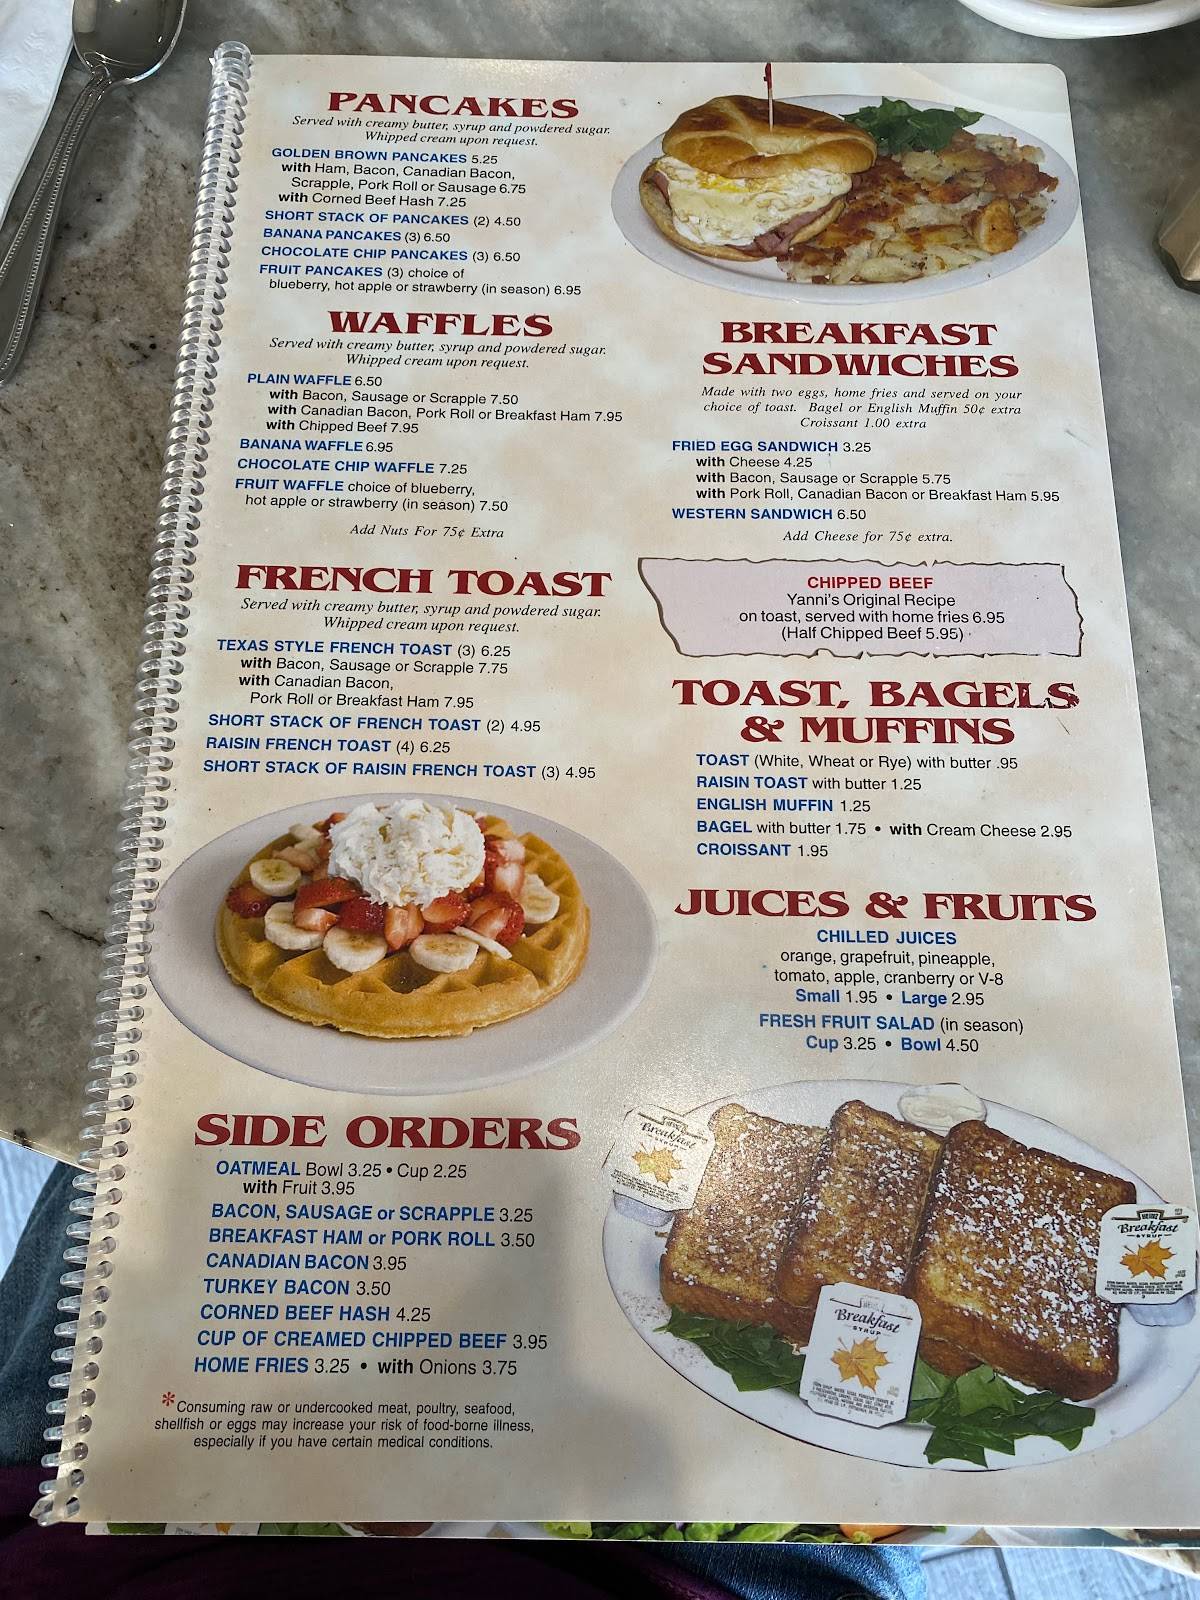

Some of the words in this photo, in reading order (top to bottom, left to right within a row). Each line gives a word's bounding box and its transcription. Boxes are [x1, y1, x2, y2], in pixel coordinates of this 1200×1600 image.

[328, 92, 578, 118] PANCAKES
[292, 115, 334, 126] Served
[337, 117, 362, 127] with
[365, 120, 409, 131] creamy
[412, 119, 449, 131] butter,
[452, 123, 486, 134] syrup
[489, 122, 513, 133] and
[514, 124, 573, 135] powdered
[576, 127, 611, 137] sugar.
[272, 147, 330, 159] GOLDEN
[335, 150, 387, 161] BROWN
[392, 152, 467, 163] PANCAKES
[471, 154, 498, 165] 5.25
[291, 176, 353, 190] Scrapple,
[358, 179, 389, 191] Pork
[393, 180, 418, 191] Roll
[421, 183, 434, 192] or
[438, 182, 496, 195] Sausage
[499, 183, 526, 194] 6.75
[261, 246, 348, 258] CHOCOLATE
[353, 248, 387, 259] CHIP
[391, 249, 468, 261] PANCAKES
[472, 251, 489, 263] (3)
[493, 252, 520, 262] 6.50
[269, 278, 330, 292] blueberry,
[334, 280, 355, 291] hot
[358, 281, 392, 294] apple
[396, 283, 409, 292] or
[412, 283, 478, 295] strawberry
[481, 284, 497, 296] (in
[500, 284, 550, 297] season)
[554, 286, 581, 296] 6.95
[328, 311, 553, 337] WAFFLES
[720, 322, 997, 345] BREAKFAST
[346, 353, 402, 368] Whipped
[405, 357, 443, 367] cream
[446, 358, 477, 369] upon
[481, 359, 529, 371] request.
[703, 353, 1019, 378] SANDWICHES
[247, 373, 290, 385] PLAIN
[294, 374, 351, 386] WAFFLE
[354, 376, 382, 387] 6.50
[266, 419, 295, 431] with
[299, 420, 353, 434] Chipped
[357, 422, 387, 433] Beef
[390, 423, 419, 433] 7.95
[800, 417, 858, 428] Croissant
[864, 417, 891, 428] 1.00
[895, 418, 927, 429] extra
[672, 440, 715, 452] FRIED
[720, 440, 752, 452] EGG
[757, 441, 838, 452] SANDWICH
[843, 442, 871, 453] 3.25
[237, 458, 330, 471] CHOCOLATE
[335, 460, 370, 472] CHIP
[374, 462, 434, 474] WAFFLE
[439, 464, 467, 475] 7.25
[696, 456, 725, 467] with
[729, 456, 780, 467] Cheese
[783, 457, 813, 467] 4.25
[696, 471, 725, 483] with
[730, 471, 775, 485] Bacon,
[780, 472, 838, 486] Sausage
[842, 474, 856, 485] or
[860, 472, 918, 486] Scrapple
[922, 473, 951, 485] 5.75
[672, 507, 746, 519] WESTERN
[750, 508, 832, 520] SANDWICH
[837, 509, 866, 520] 6.50
[349, 523, 376, 535] Add
[381, 524, 409, 536] Nuts
[414, 525, 438, 537] For
[471, 527, 504, 539] Extra
[235, 565, 434, 593] FRENCH
[448, 570, 612, 597] TOAST
[807, 576, 881, 589] CHIPPED
[889, 577, 933, 589] BEEF
[787, 593, 839, 606] Yanni's
[843, 593, 900, 608] Original
[904, 594, 956, 609] Recipe
[781, 627, 816, 642] (Half
[820, 627, 883, 642] Chipped
[887, 627, 922, 640] Beef
[926, 628, 964, 643] 5.95)
[217, 639, 269, 652] TEXAS
[274, 640, 324, 653] STYLE
[330, 642, 394, 654] FRENCH
[399, 644, 452, 656] TOAST
[457, 644, 476, 658] (3)
[481, 646, 511, 657] 6.25
[672, 680, 850, 708] TOAST,
[869, 682, 1079, 709] BAGELS
[740, 716, 784, 742] &
[800, 717, 1015, 745] MUFFINS
[206, 736, 260, 750] RAISIN
[266, 738, 331, 751] FRENCH
[337, 739, 391, 752] TOAST
[396, 740, 415, 755] (4)
[420, 742, 450, 754] 6.25
[696, 776, 749, 788] RAISIN
[754, 777, 808, 789] TOAST
[812, 777, 840, 790] with
[845, 778, 887, 790] butter
[891, 778, 922, 791] 1.25
[696, 798, 767, 811] ENGLISH
[773, 799, 833, 812] MUFFIN
[840, 800, 871, 812] 1.25
[697, 843, 791, 856] CROISSANT
[798, 845, 828, 857] 1.95
[674, 889, 849, 917] JUICES
[865, 891, 907, 918] &
[924, 893, 1097, 922] FRUITS
[817, 930, 889, 944] CHILLED
[896, 932, 957, 945] JUICES
[780, 952, 836, 966] orange,
[840, 950, 914, 967] grapefruit,
[919, 952, 995, 968] pineapple,
[759, 1014, 816, 1029] FRESH
[822, 1015, 871, 1029] FRUIT
[876, 1016, 935, 1031] SALAD
[940, 1017, 959, 1034] (in
[963, 1018, 1024, 1035] season)
[195, 1114, 327, 1147] SIDE
[346, 1116, 581, 1150] ORDERS
[243, 1180, 277, 1195] with
[282, 1180, 317, 1195] Fruit
[321, 1181, 355, 1196] 3.95
[212, 1203, 280, 1221] BACON,
[286, 1204, 372, 1221] SAUSAGE
[377, 1208, 396, 1221] or
[400, 1206, 495, 1222] SCRAPPLE
[499, 1207, 533, 1223] 3.25
[1117, 1220, 1179, 1233] Breakfast
[204, 1278, 278, 1294] TURKEY
[284, 1279, 349, 1296] BACON
[355, 1281, 391, 1296] 3.50
[200, 1304, 279, 1320] CORNED
[285, 1305, 333, 1321] BEEF
[339, 1306, 390, 1322] HASH
[396, 1307, 431, 1322] 4.25
[835, 1308, 901, 1333] Breakfast
[193, 1435, 254, 1450] especially
[258, 1435, 267, 1448] if
[270, 1438, 293, 1451] you
[297, 1435, 328, 1448] have
[331, 1435, 373, 1448] certain
[377, 1436, 424, 1449] medical
[429, 1436, 493, 1449] conditions.
